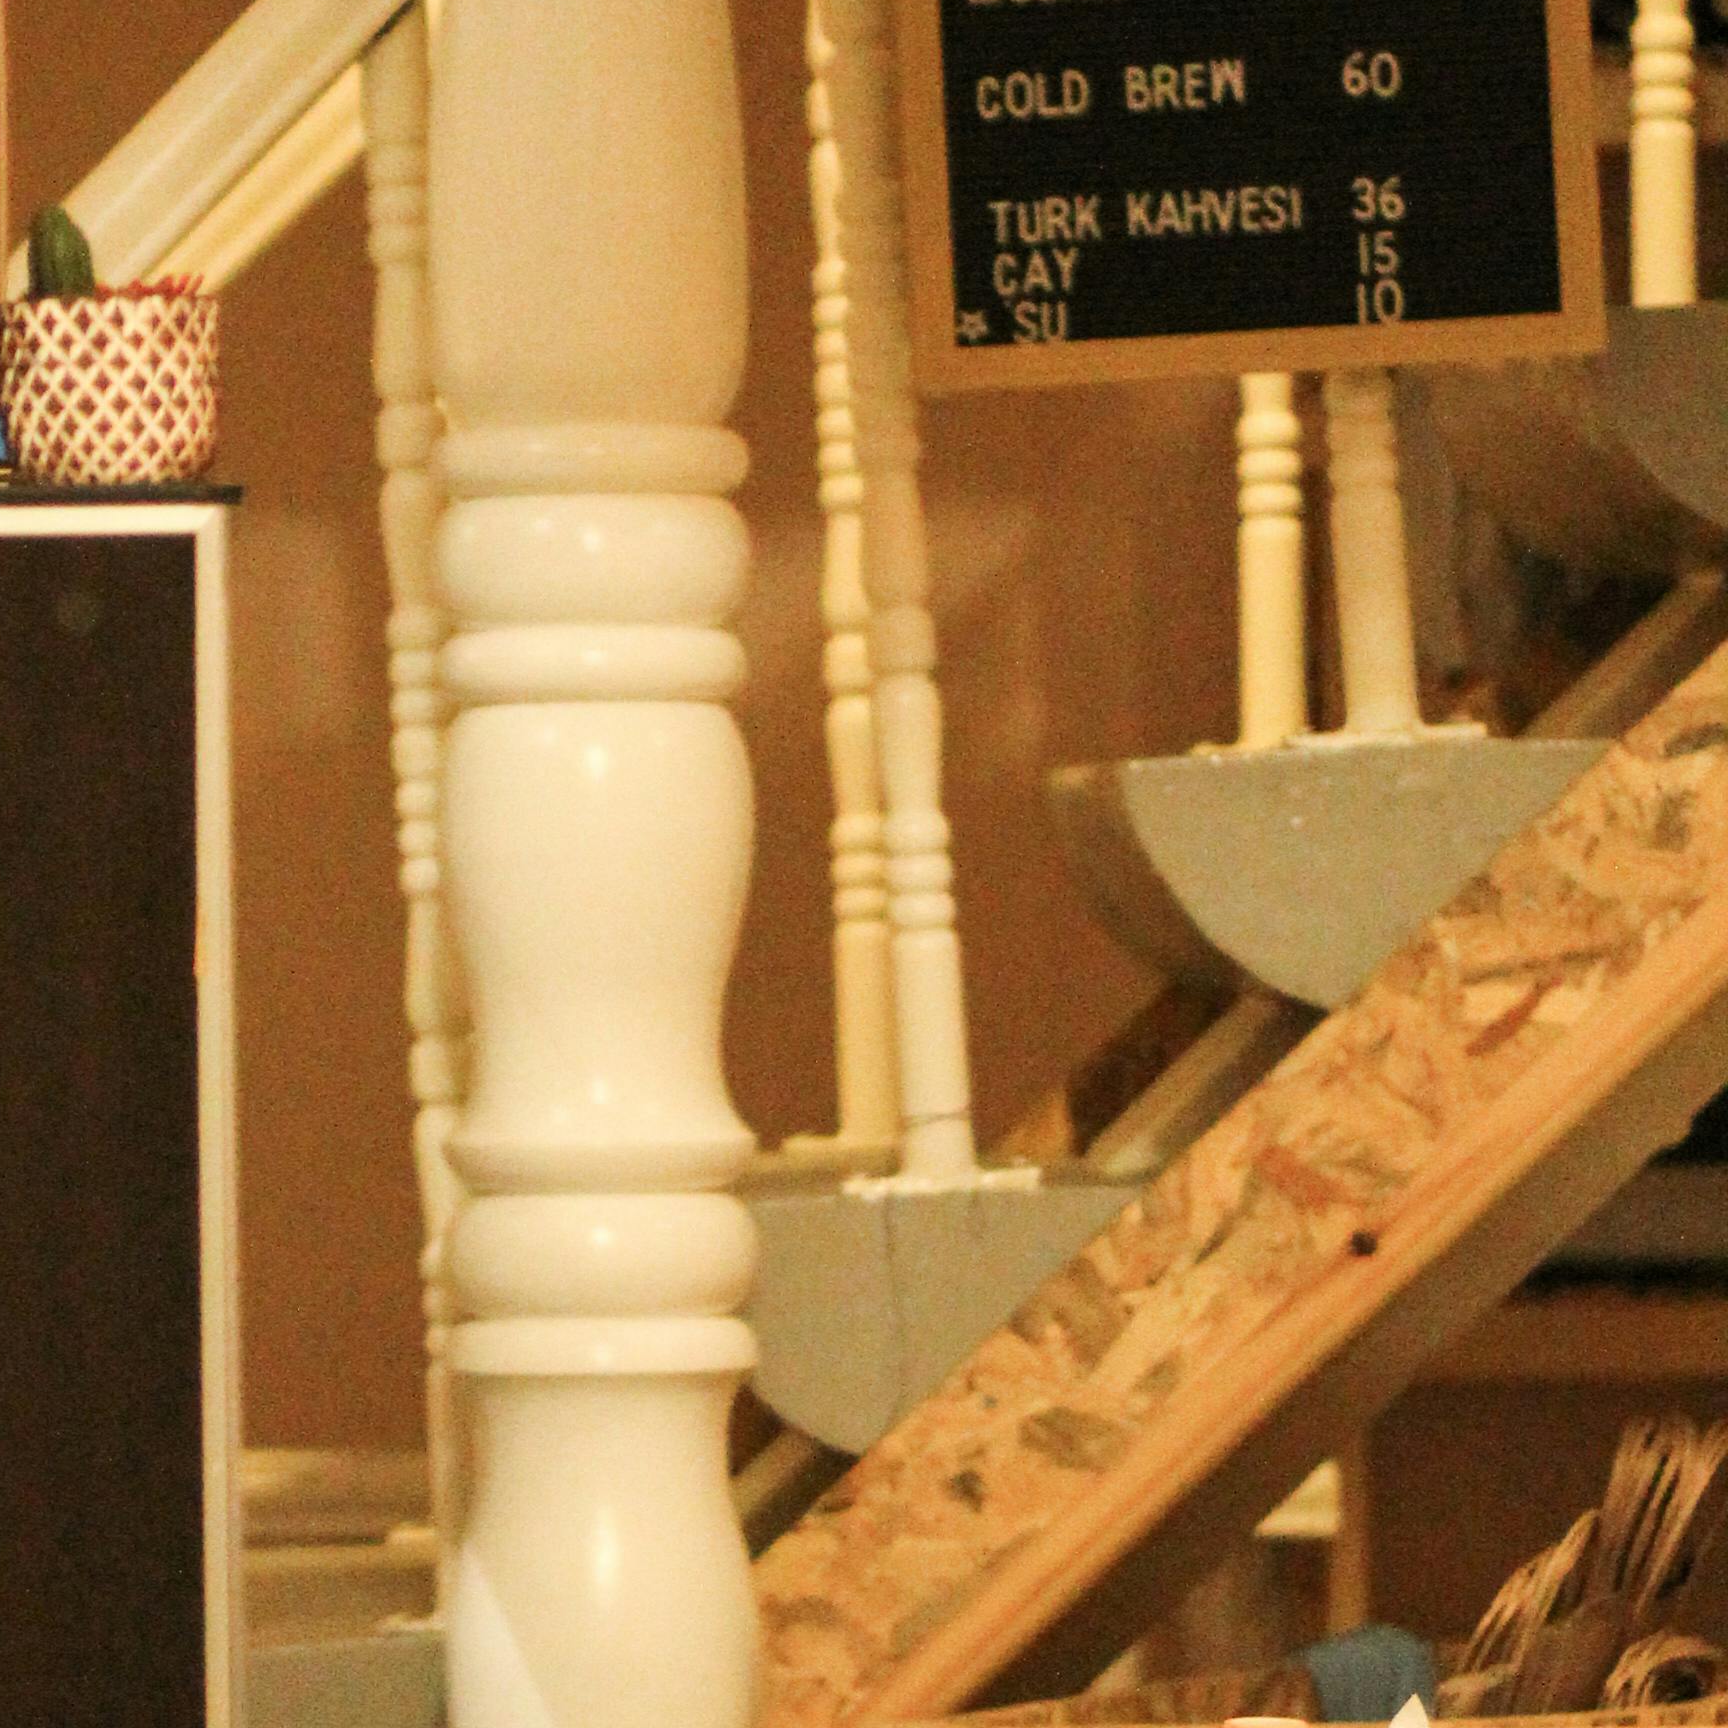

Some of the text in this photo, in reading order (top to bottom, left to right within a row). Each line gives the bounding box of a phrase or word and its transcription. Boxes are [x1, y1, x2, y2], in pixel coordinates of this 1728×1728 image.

[976, 51, 1402, 122] COLD BREW 60
[989, 176, 1406, 245] TURK KAHVESI 36
[1358, 230, 1399, 276] 15
[1013, 278, 1405, 345] SU 10
